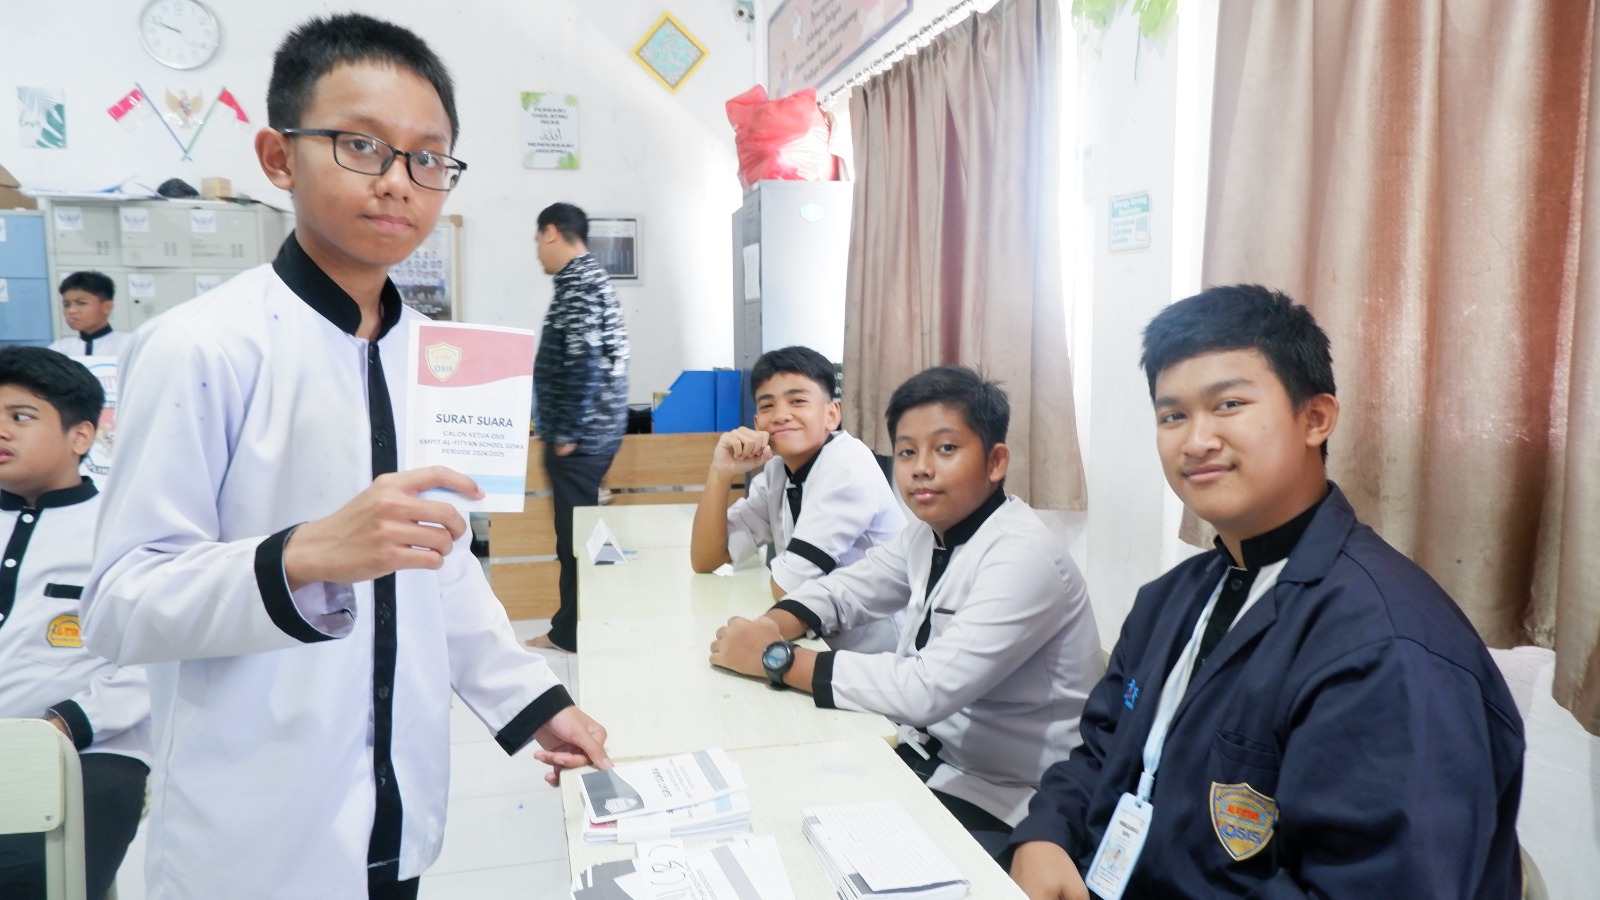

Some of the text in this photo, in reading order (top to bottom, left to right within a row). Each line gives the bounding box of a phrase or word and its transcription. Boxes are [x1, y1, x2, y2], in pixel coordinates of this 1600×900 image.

[435, 413, 513, 428] SURAT SUARA
[419, 438, 441, 446] SMPIT
[442, 440, 477, 448] AL-FITYAN
[441, 448, 471, 456] PERIODE
[1220, 823, 1261, 843] OSIS
